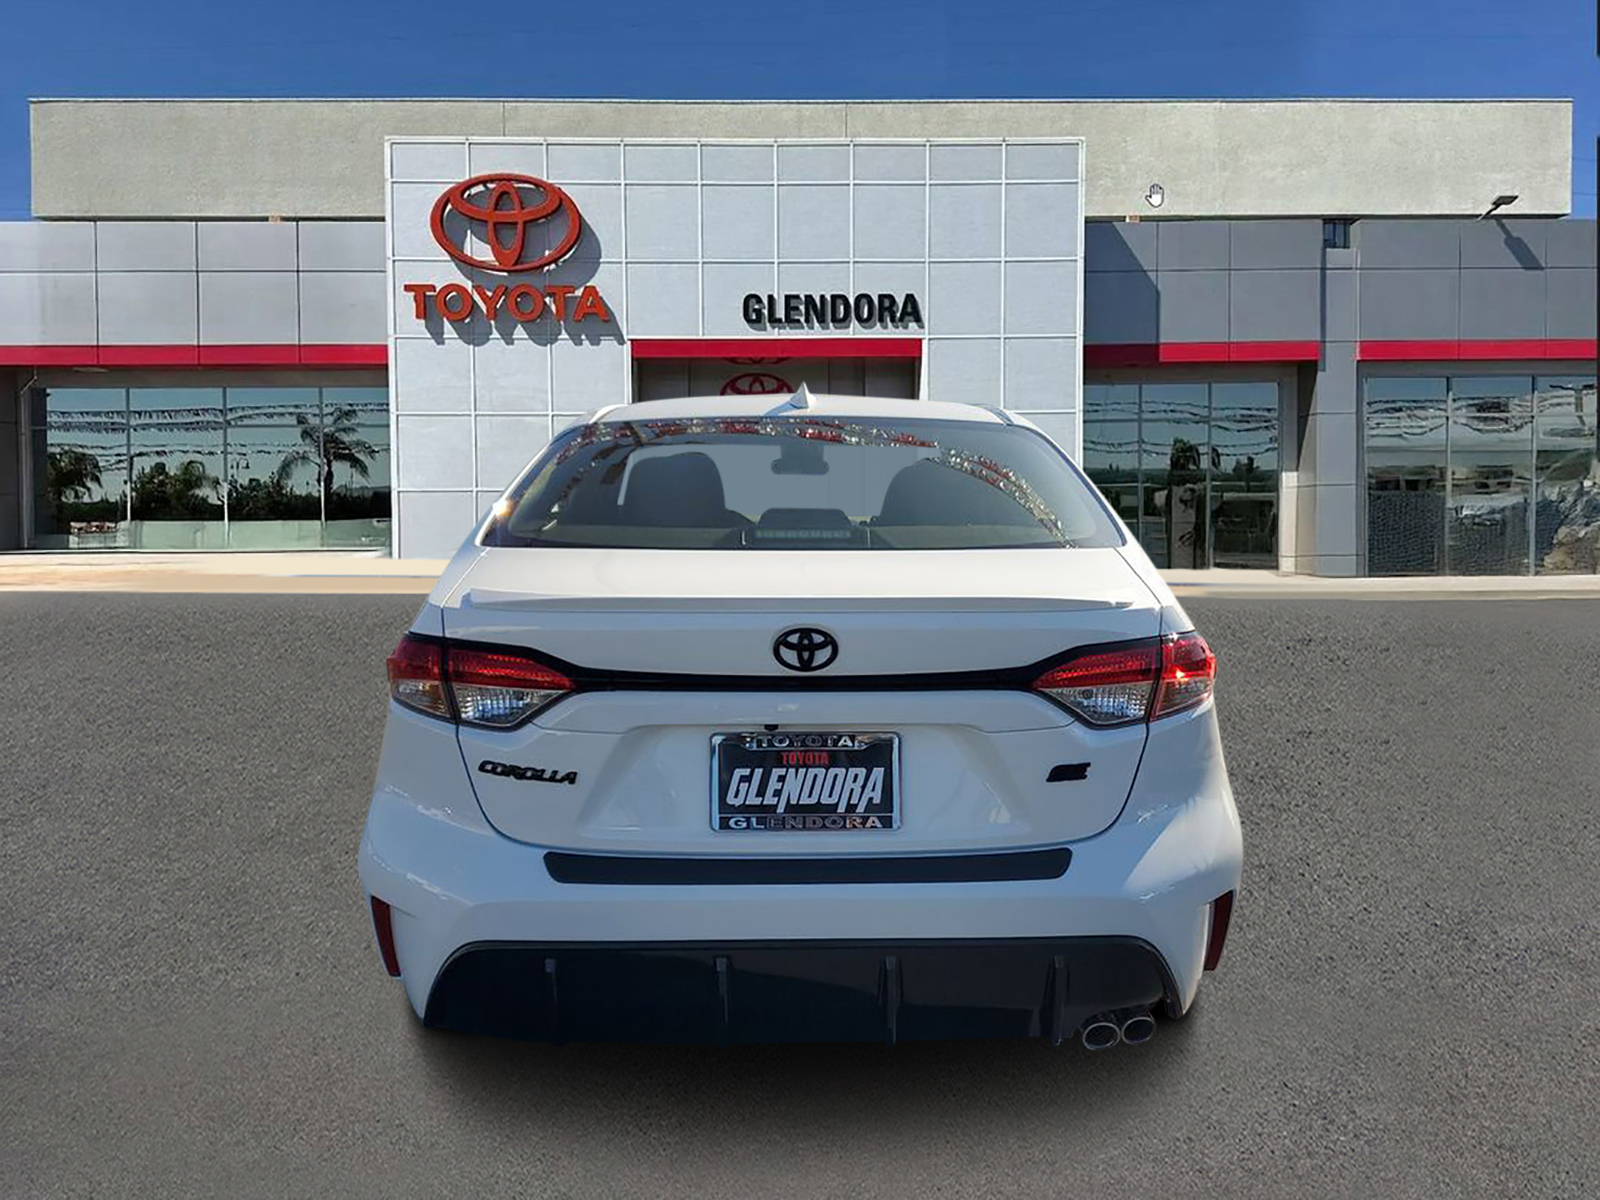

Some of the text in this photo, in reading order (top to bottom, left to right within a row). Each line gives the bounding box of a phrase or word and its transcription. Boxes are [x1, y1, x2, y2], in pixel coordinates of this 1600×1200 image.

[404, 284, 610, 323] TOYOTA
[743, 293, 923, 325] GLENDORA
[758, 735, 854, 748] TOYOTA
[781, 751, 829, 765] TOYOTA
[478, 760, 578, 785] COROLLA
[726, 767, 885, 814] GLENDORA
[728, 816, 883, 830] GLENDORA
